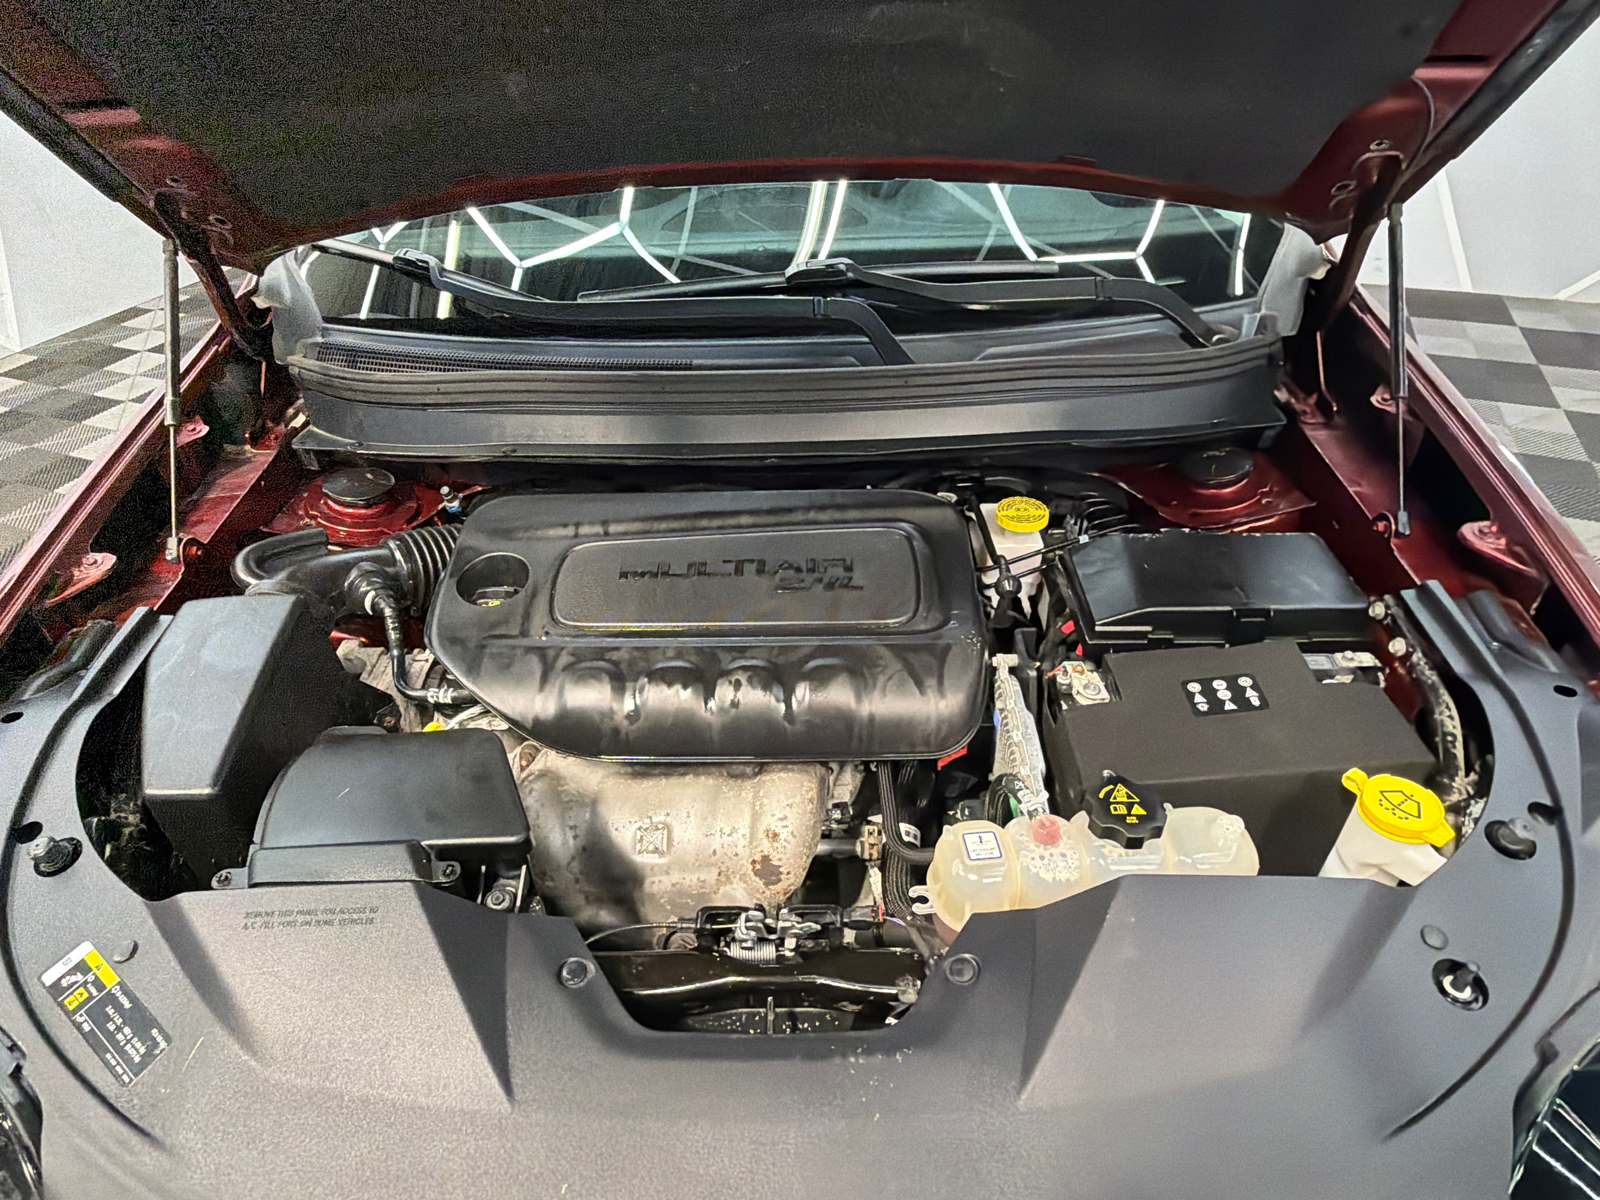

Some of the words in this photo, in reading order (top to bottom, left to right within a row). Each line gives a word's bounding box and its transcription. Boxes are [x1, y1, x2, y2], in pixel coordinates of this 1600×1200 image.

[619, 557, 854, 581] MULTIAIR
[295, 908, 319, 917] PANEL
[337, 907, 367, 915] ACCESS
[369, 905, 379, 913] TO
[338, 917, 374, 926] VEHICLES
